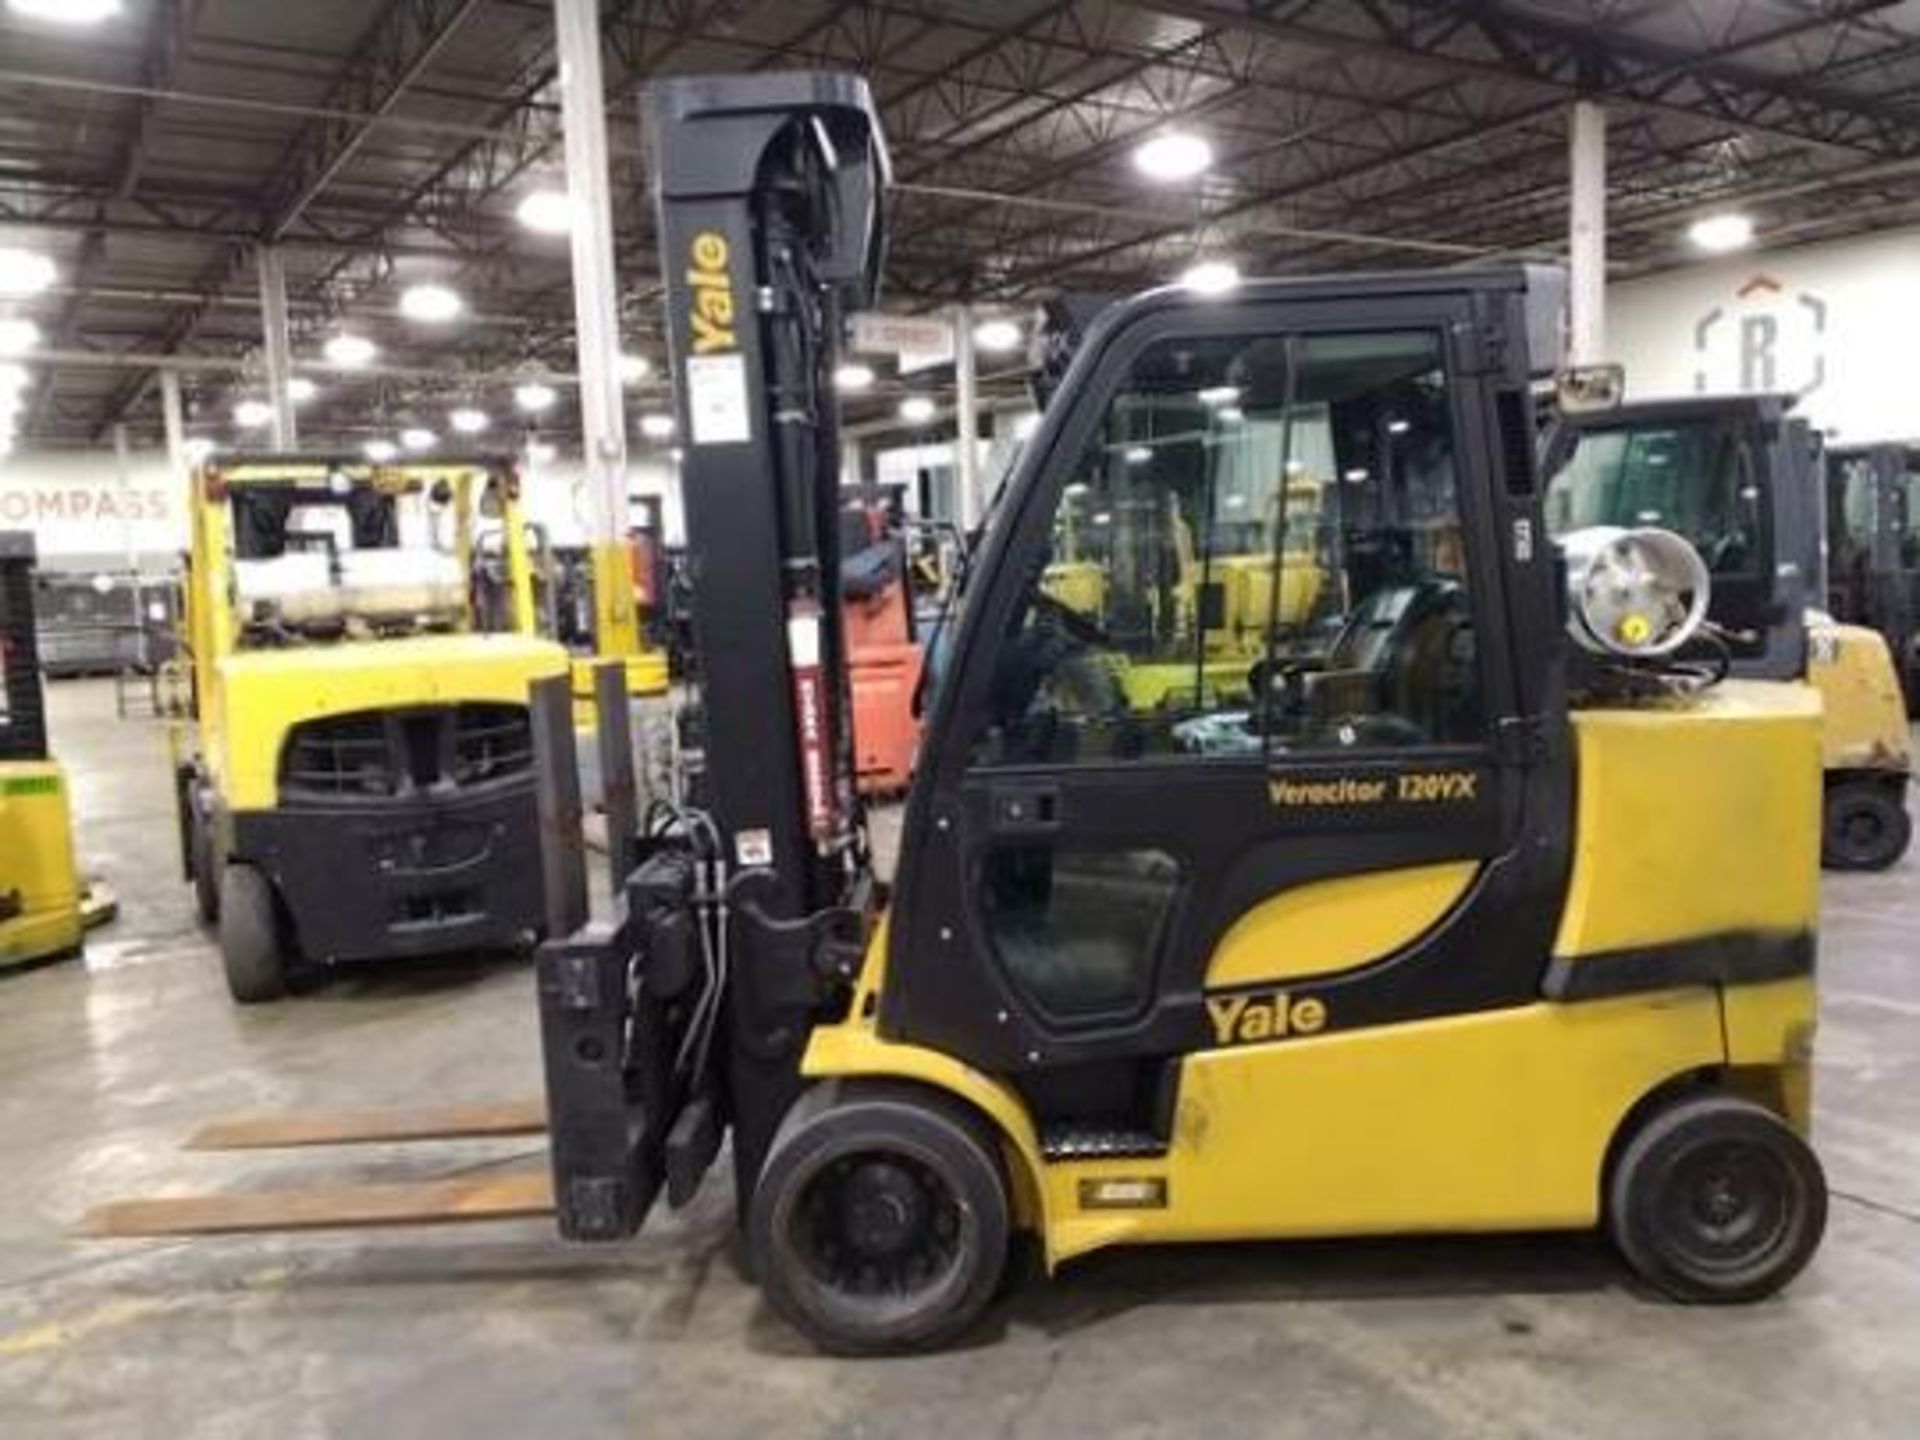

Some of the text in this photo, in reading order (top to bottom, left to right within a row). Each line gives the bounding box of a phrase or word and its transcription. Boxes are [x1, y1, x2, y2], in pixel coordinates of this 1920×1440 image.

[686, 233, 735, 354] Yale
[1741, 314, 1777, 391] R
[1398, 773, 1477, 799] 120VX
[1205, 991, 1328, 1043] Yale
